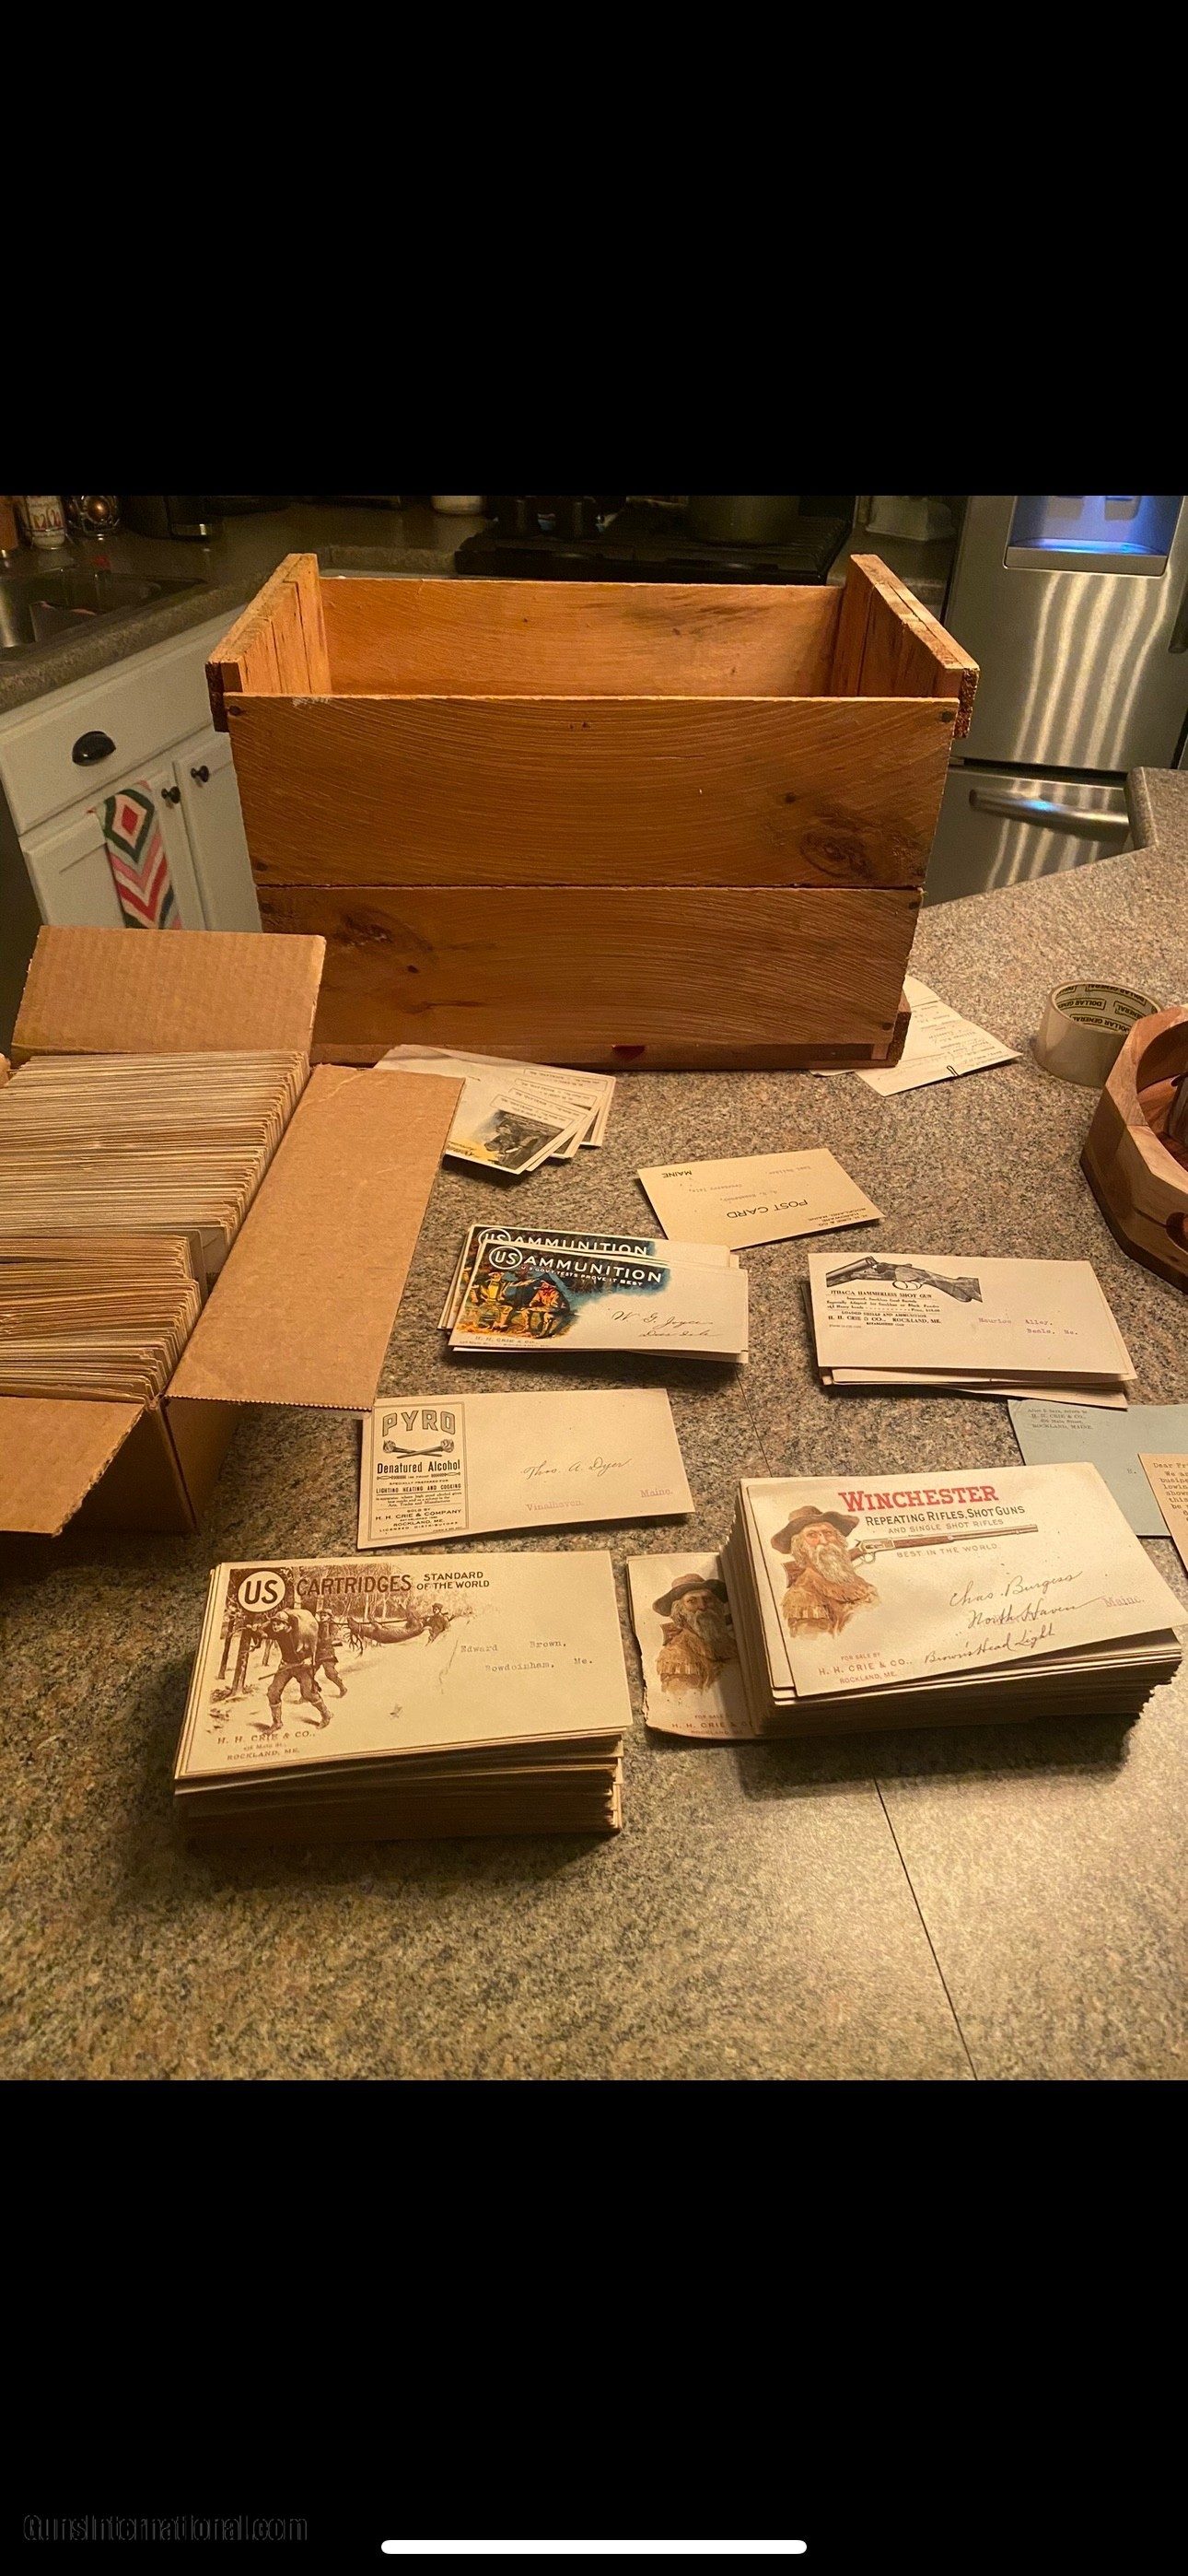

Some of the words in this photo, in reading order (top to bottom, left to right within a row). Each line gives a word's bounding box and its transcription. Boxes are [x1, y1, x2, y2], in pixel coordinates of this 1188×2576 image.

[661, 1169, 693, 1178] MAINE
[727, 1205, 769, 1219] CARD
[774, 1199, 809, 1212] POST
[523, 1255, 663, 1284] AMMUNITION
[382, 1410, 456, 1437] PYRO
[377, 1461, 423, 1474] Denatured
[428, 1458, 460, 1471] Alcohol
[588, 1456, 633, 1477] Dyer
[838, 1485, 999, 1512] WINCHESTER
[866, 1511, 926, 1527] REPEATING
[967, 1507, 995, 1519] SHOT
[995, 1505, 1026, 1516] GUNS
[973, 1519, 1004, 1528] RIFLES
[897, 1550, 921, 1558] BEST
[963, 1543, 997, 1552] WORLD
[242, 1577, 280, 1606] US
[296, 1574, 412, 1597] CARTRIDGES
[424, 1571, 483, 1581] STANDARD
[434, 1581, 455, 1590] THE
[455, 1580, 490, 1589] WORLD
[968, 1604, 1018, 1629] North
[1015, 1622, 1055, 1648] Light
[460, 1645, 498, 1653] Edward
[849, 1663, 875, 1672] CRIE
[251, 1733, 278, 1742] CRIE
